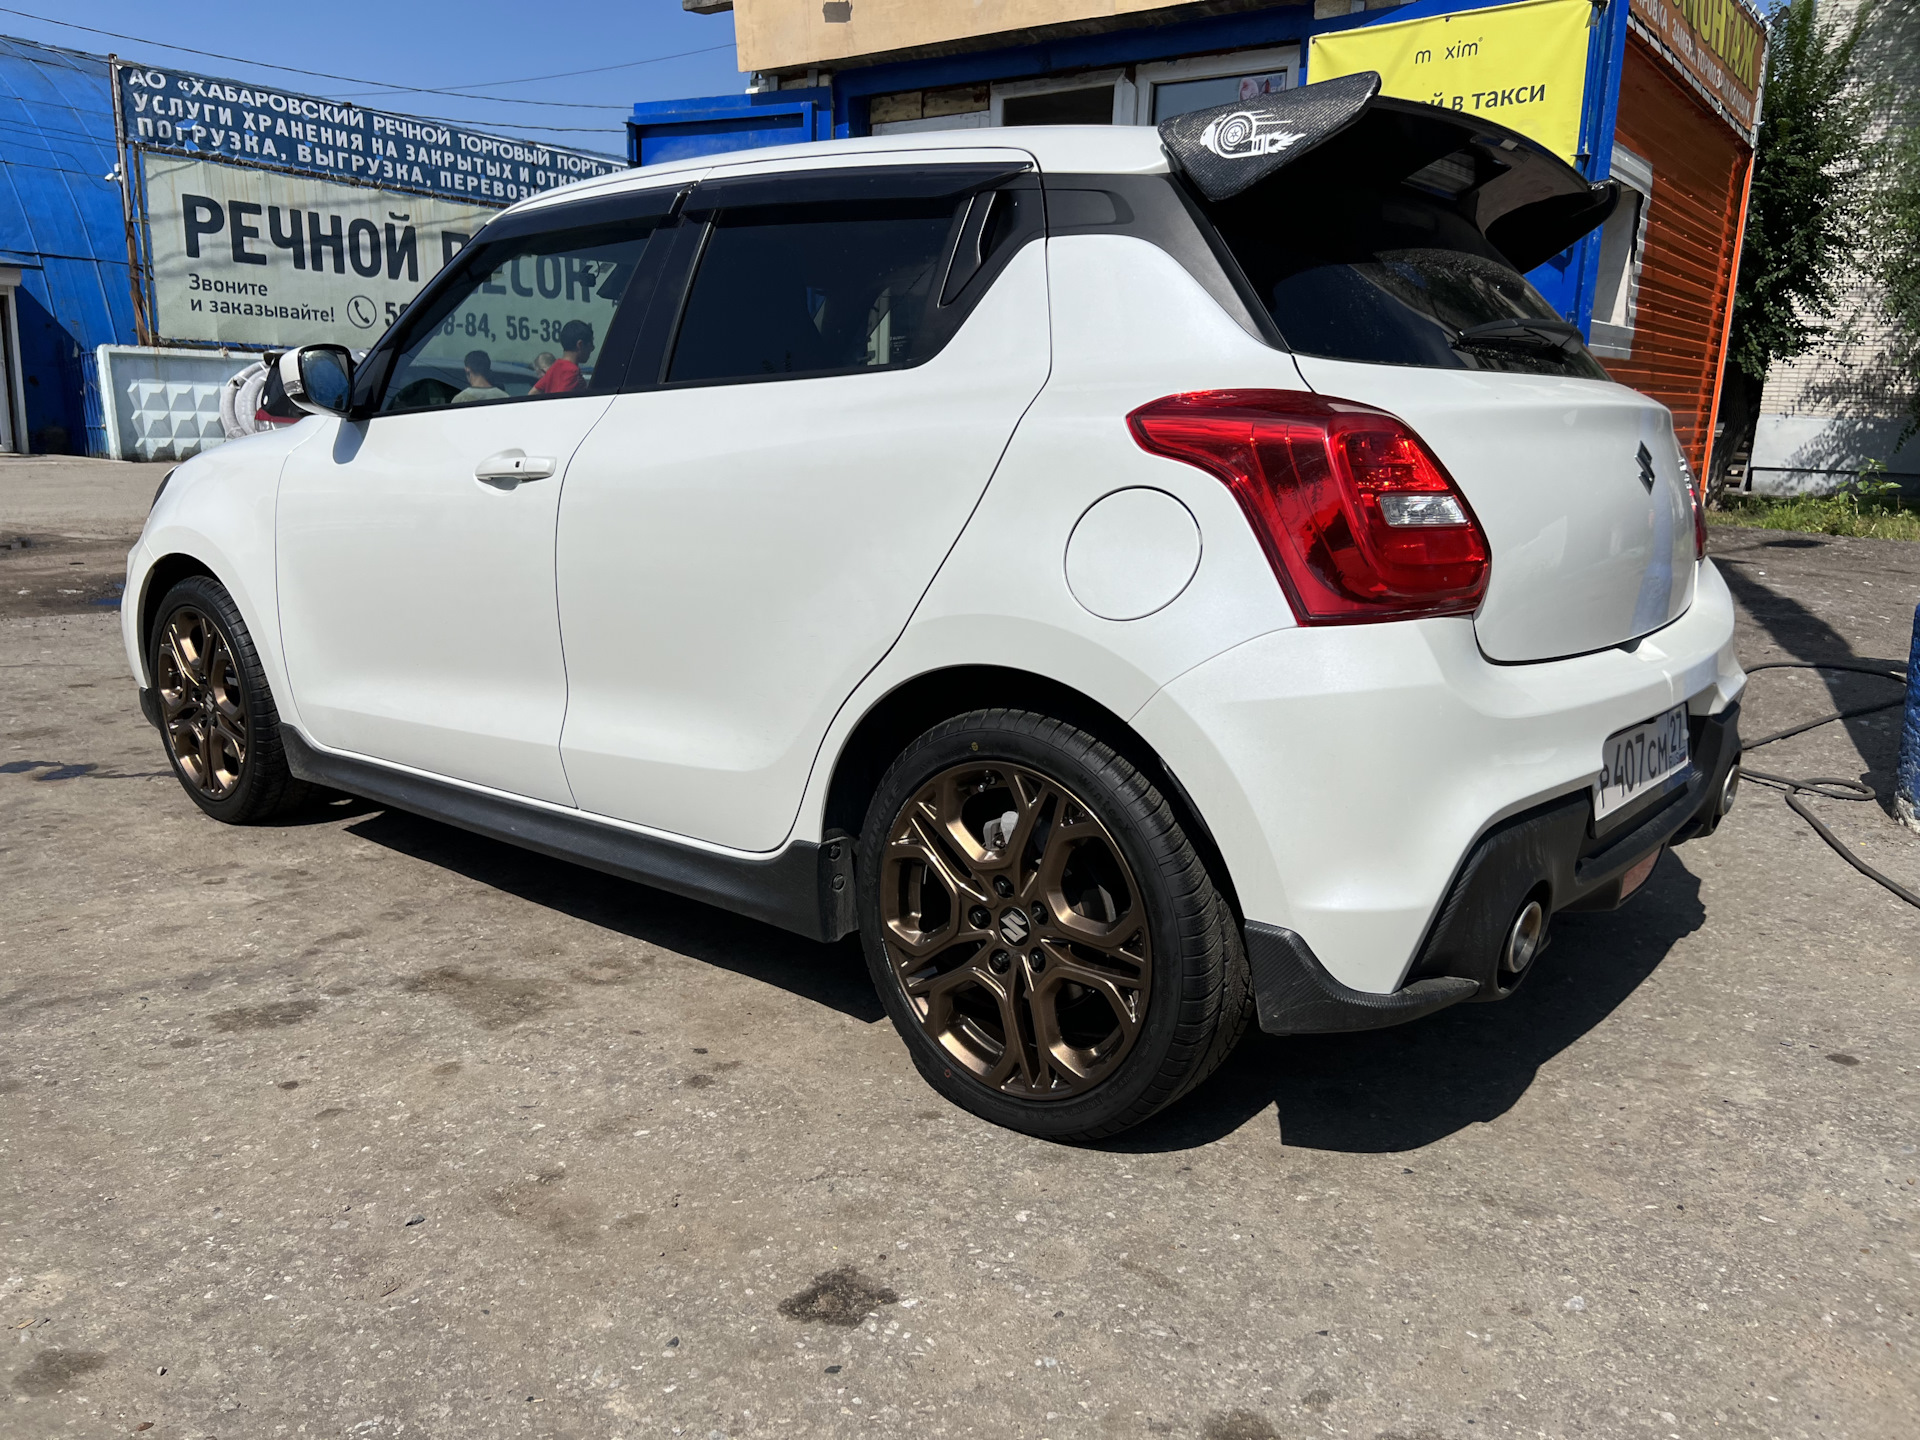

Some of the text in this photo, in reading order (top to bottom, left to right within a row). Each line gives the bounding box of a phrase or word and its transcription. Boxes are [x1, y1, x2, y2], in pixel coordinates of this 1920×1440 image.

[1472, 84, 1546, 109] такси
[128, 69, 606, 176] АО «ХАБАРОВСКИЙ РЕЧНОЙ ТОРГОВЫЙ ПОРТ»
[133, 92, 587, 187] УСЛУГИ ХРАНЕНИЯ НА ЗАКРЫТЫХ И ОТКР
[297, 143, 431, 187] ВЫГРУЗКА,
[182, 193, 419, 282] РЕЧНОЙ
[188, 273, 268, 296] Звоните
[191, 299, 335, 322] и заказывайте!
